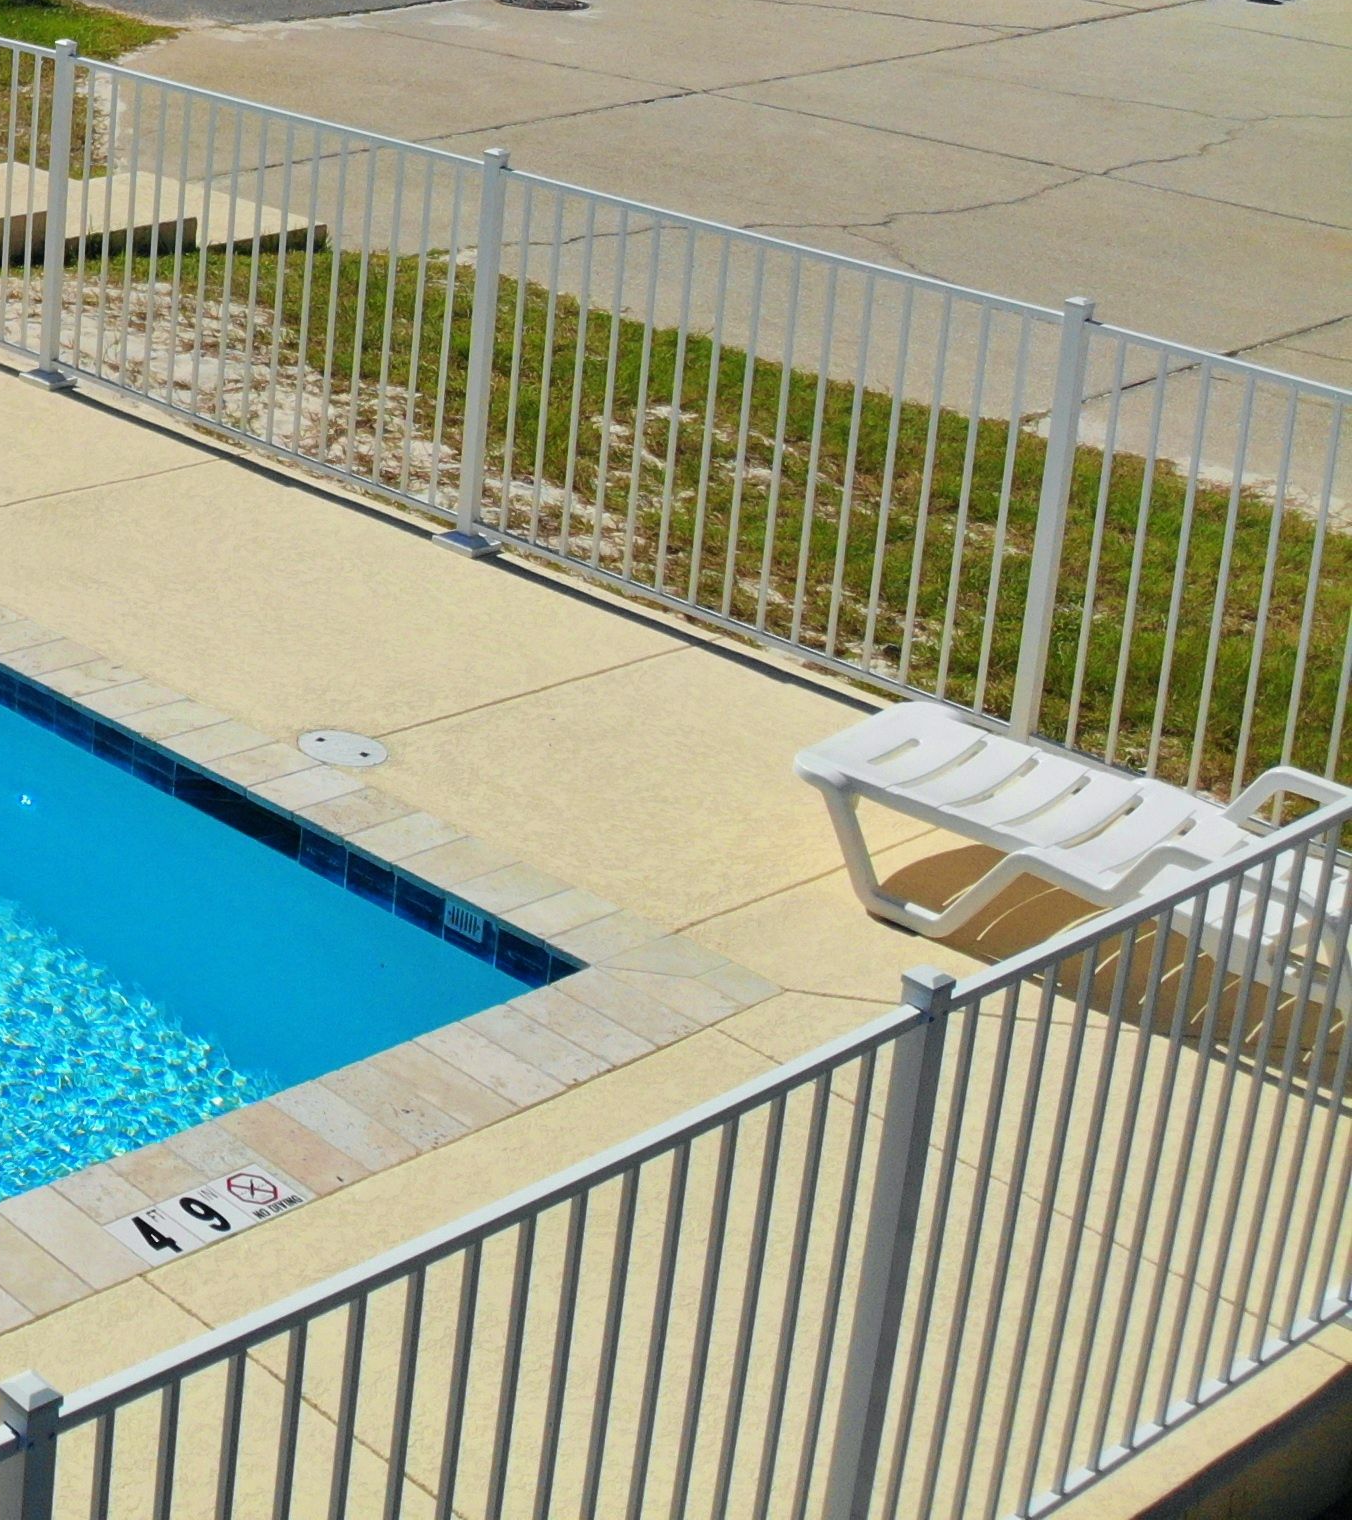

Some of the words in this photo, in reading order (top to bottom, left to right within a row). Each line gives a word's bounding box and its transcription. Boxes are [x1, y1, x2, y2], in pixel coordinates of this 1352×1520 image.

[131, 1215, 183, 1254] 4
[178, 1196, 232, 1233] 9
[252, 1208, 272, 1220] NO
[267, 1194, 304, 1214] DIVING
